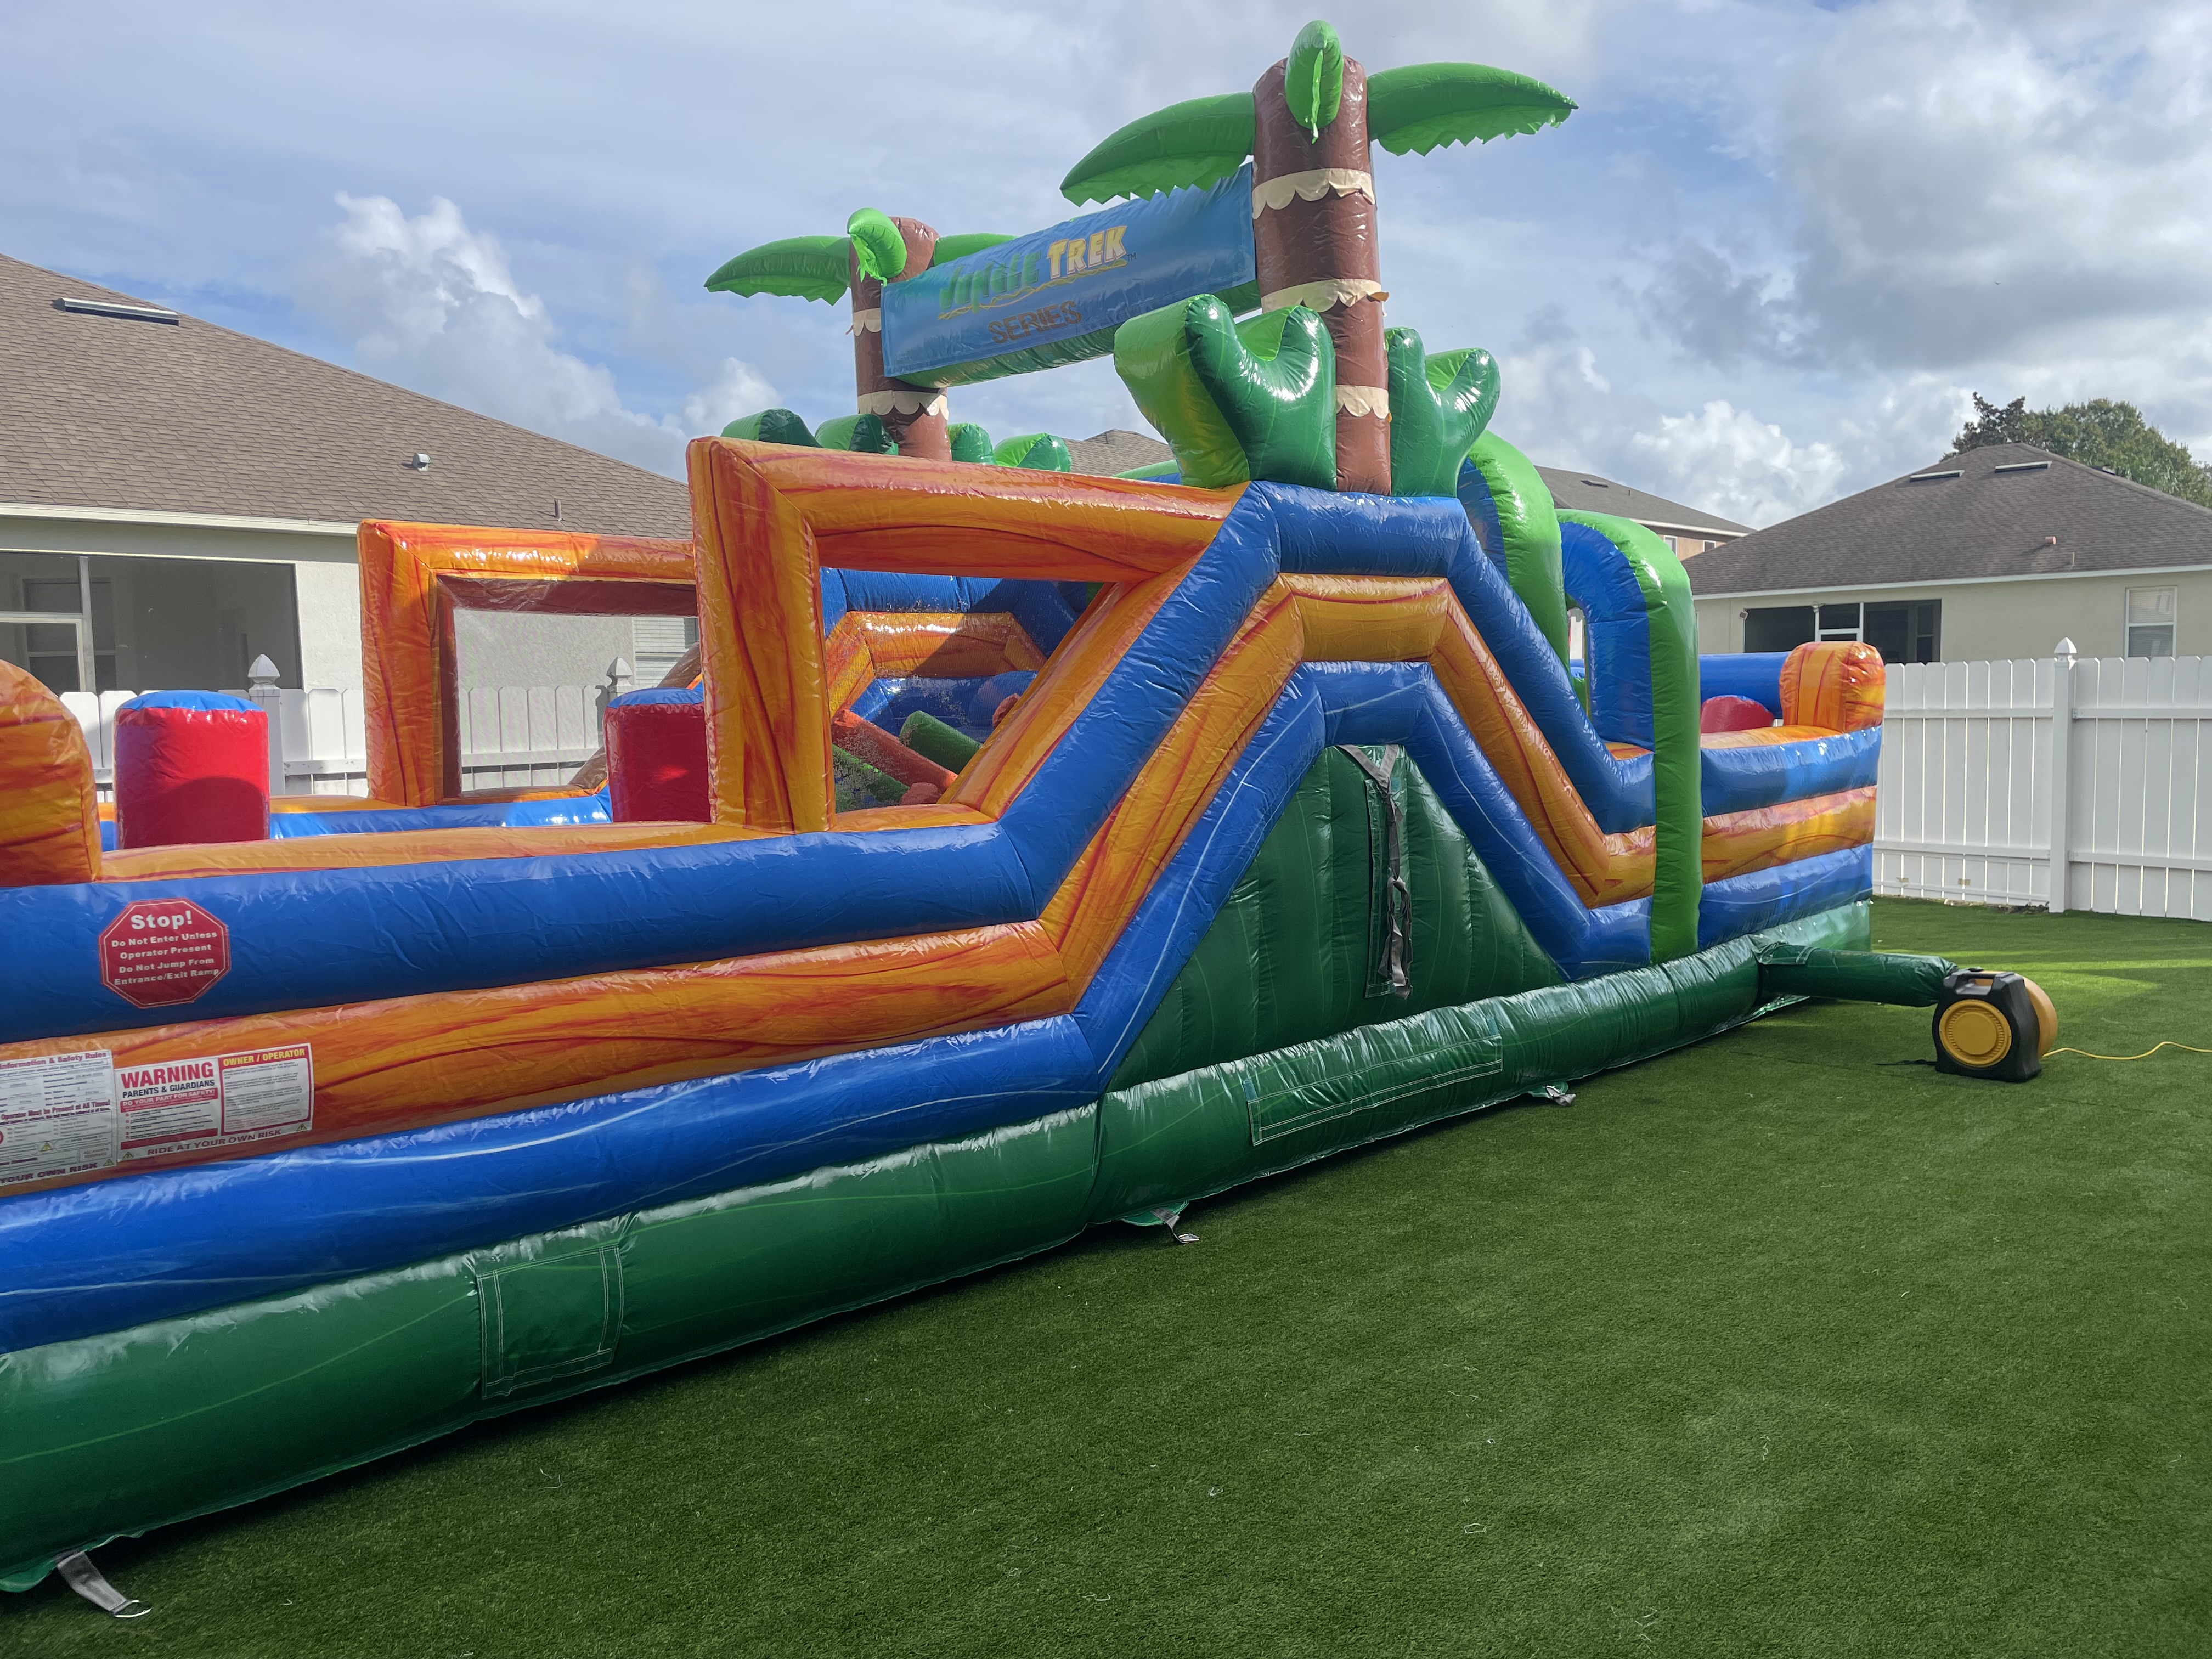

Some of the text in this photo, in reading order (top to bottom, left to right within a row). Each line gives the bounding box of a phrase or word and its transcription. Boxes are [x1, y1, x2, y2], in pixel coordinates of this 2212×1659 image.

[940, 252, 1041, 312] JUNGLE
[1046, 225, 1127, 279] TREK
[988, 300, 1082, 344] SERIES
[131, 910, 193, 930] Stop!
[128, 938, 148, 946] Not
[150, 935, 179, 944] Enter
[181, 932, 217, 940] Unless
[120, 943, 212, 960] Operator Present
[157, 960, 185, 969] Jump
[114, 969, 219, 986] Entrance/Exit Ramp
[223, 1056, 255, 1066] OWNER
[262, 1048, 306, 1062] OPERATOR
[121, 1062, 214, 1089] WARNING
[122, 1087, 159, 1098] PARENTS
[170, 1079, 215, 1092] GUARDIANS
[147, 1128, 281, 1155] RIDE AT YOUR OWN RISK
[37, 1168, 66, 1178] OWN
[70, 1162, 98, 1173] RISK
